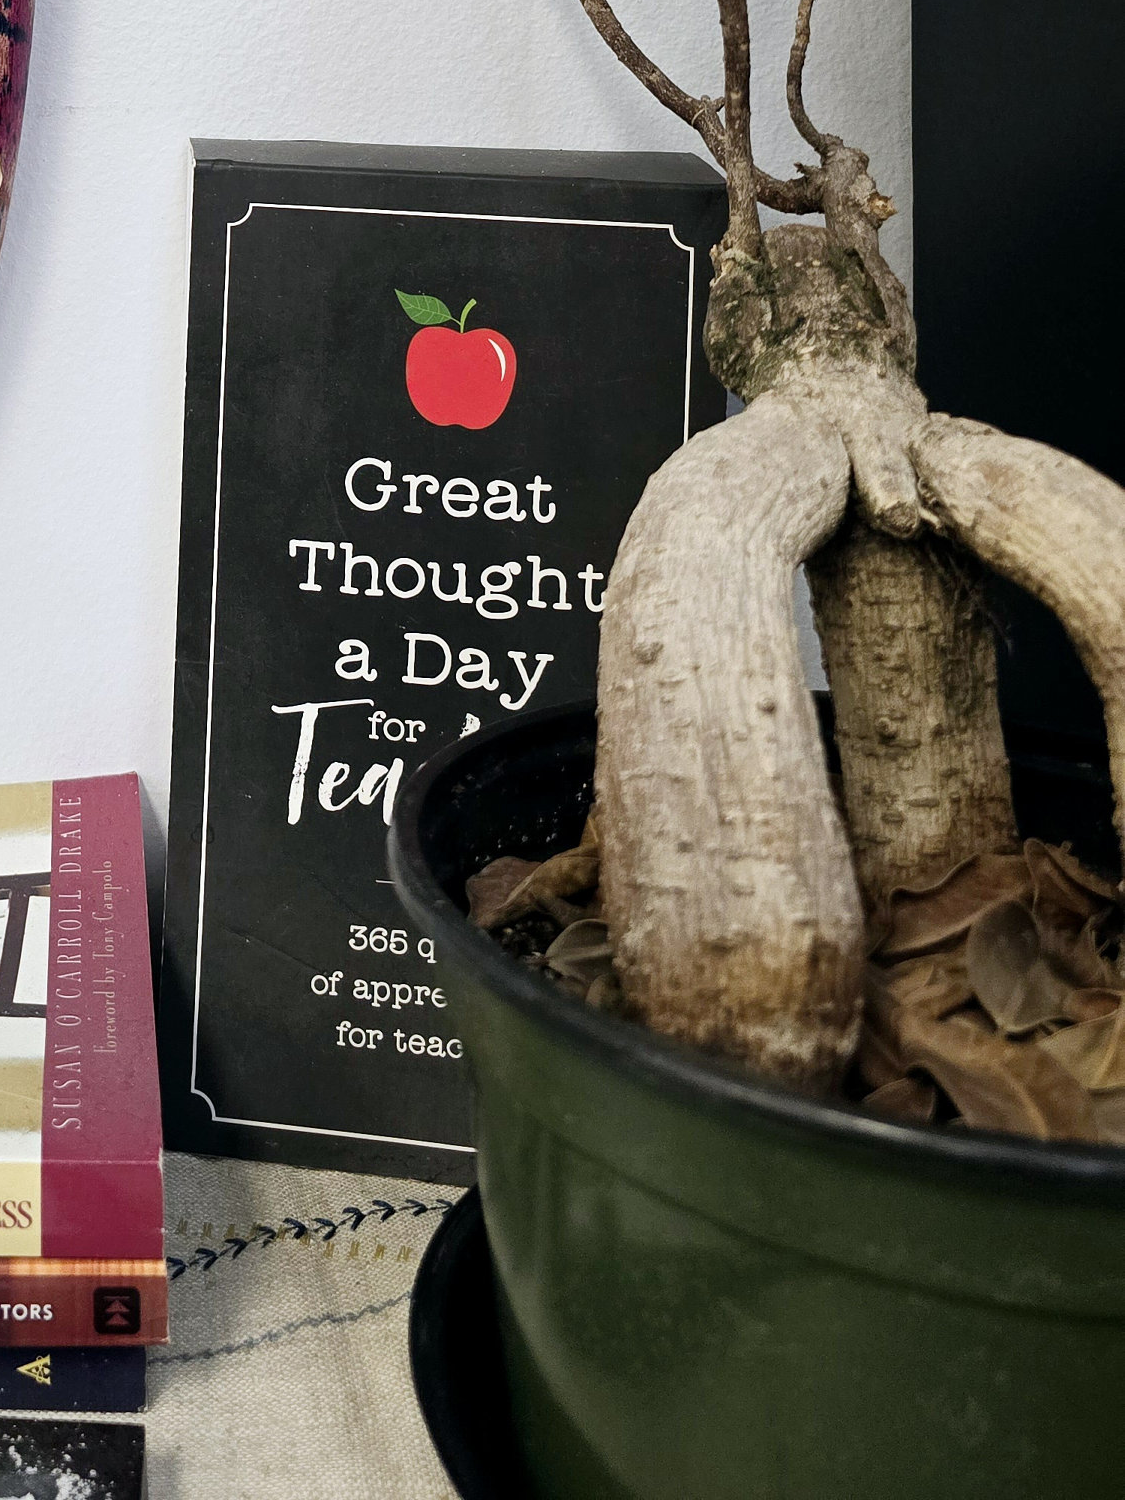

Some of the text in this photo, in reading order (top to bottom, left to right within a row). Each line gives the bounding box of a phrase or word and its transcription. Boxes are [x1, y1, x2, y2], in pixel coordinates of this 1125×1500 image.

[345, 457, 557, 524] Great
[288, 539, 607, 620] Thought
[334, 632, 555, 710] a Day
[367, 710, 426, 743] for
[50, 795, 84, 1131] SUSAN O'CARROLL DRAKE
[91, 859, 126, 1056] Foreword by Tony Campolo
[348, 924, 408, 955] 365
[310, 970, 448, 1010] of appre
[335, 1020, 464, 1060] for teac
